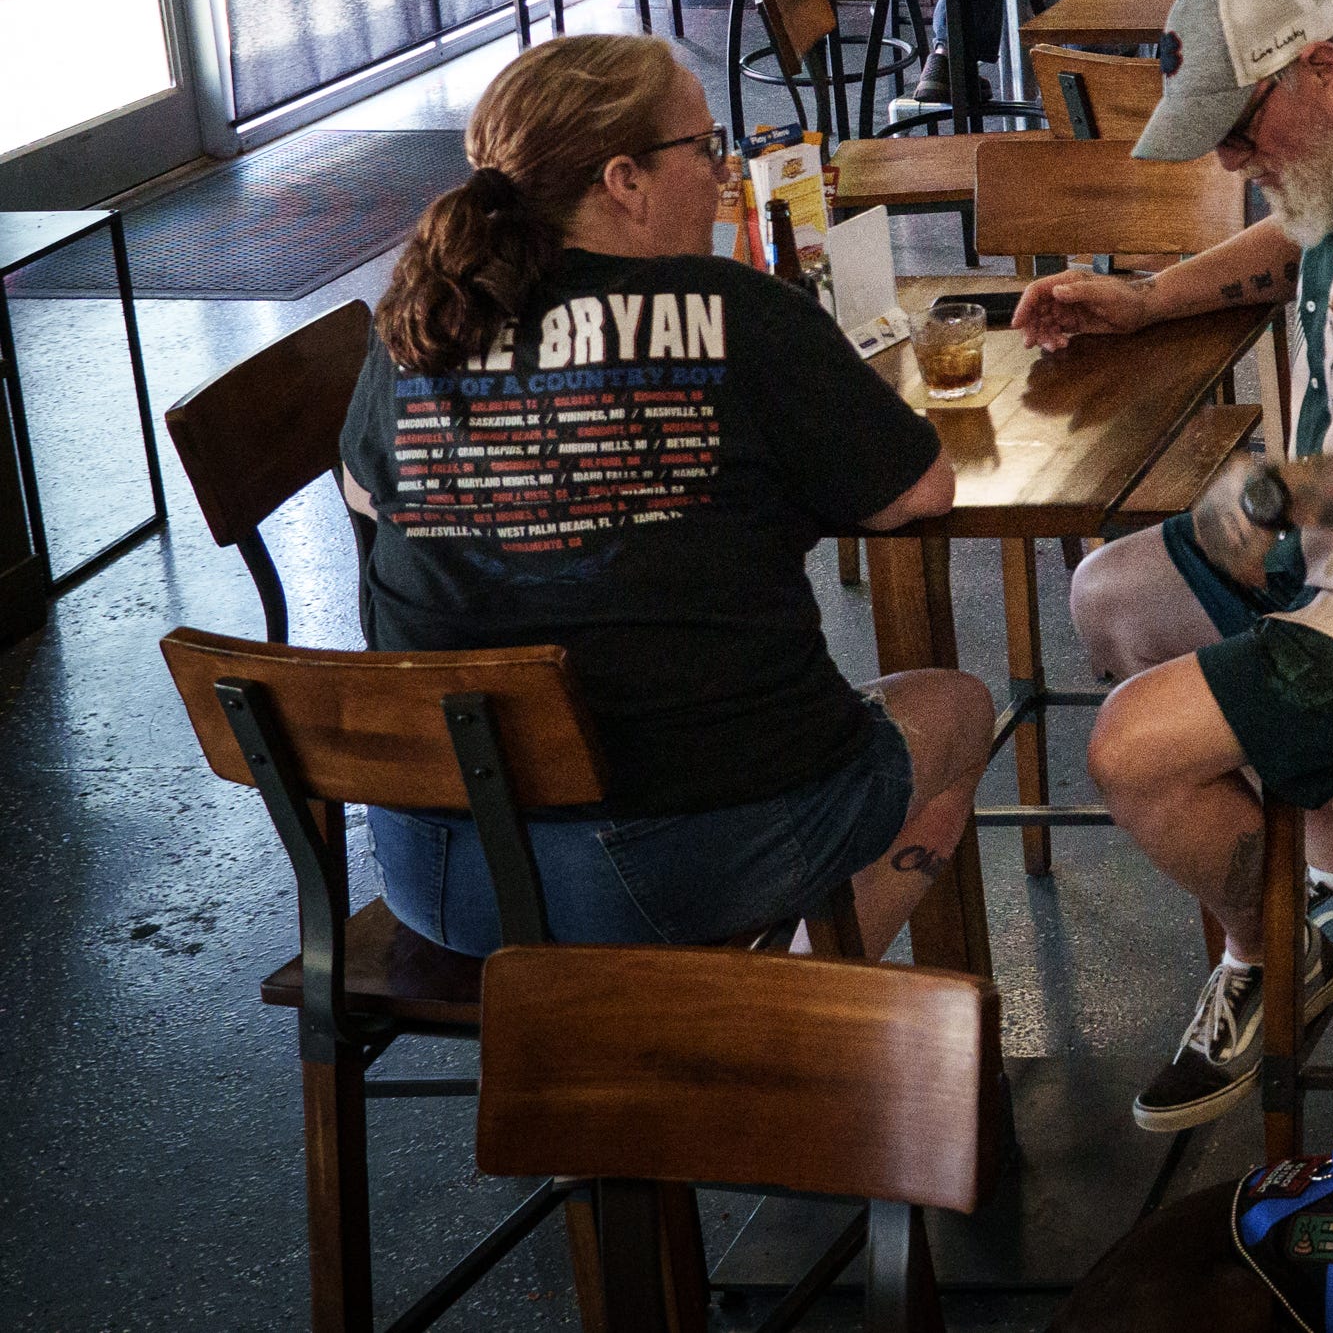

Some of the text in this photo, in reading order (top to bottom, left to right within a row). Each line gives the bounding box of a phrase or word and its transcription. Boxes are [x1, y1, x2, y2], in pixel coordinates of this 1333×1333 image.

[1275, 27, 1309, 50] Lucky
[537, 292, 728, 370] BRYAN
[460, 365, 728, 397] OF A COUNTRY BOY
[468, 406, 699, 428] SASKATOON, SK WINNIPEG, NASHVILLE,
[458, 445, 485, 457] GRAND
[486, 445, 525, 457] RAPIDS,
[558, 442, 598, 455] AUBURN
[600, 440, 633, 452] HILLS,
[634, 439, 648, 450] MI
[666, 436, 707, 449] BETHEL,
[456, 476, 501, 489] MARYLAND
[502, 474, 539, 487] HEIGHTS,
[572, 470, 604, 482] IDAHO
[672, 466, 709, 479] NAMPA,
[406, 525, 472, 539] NOBLESVILLE,
[497, 525, 526, 539] WEST
[528, 523, 557, 536] PALM
[558, 519, 597, 533] BEACH,
[598, 516, 613, 529] FL
[632, 510, 671, 525] TAMPA,
